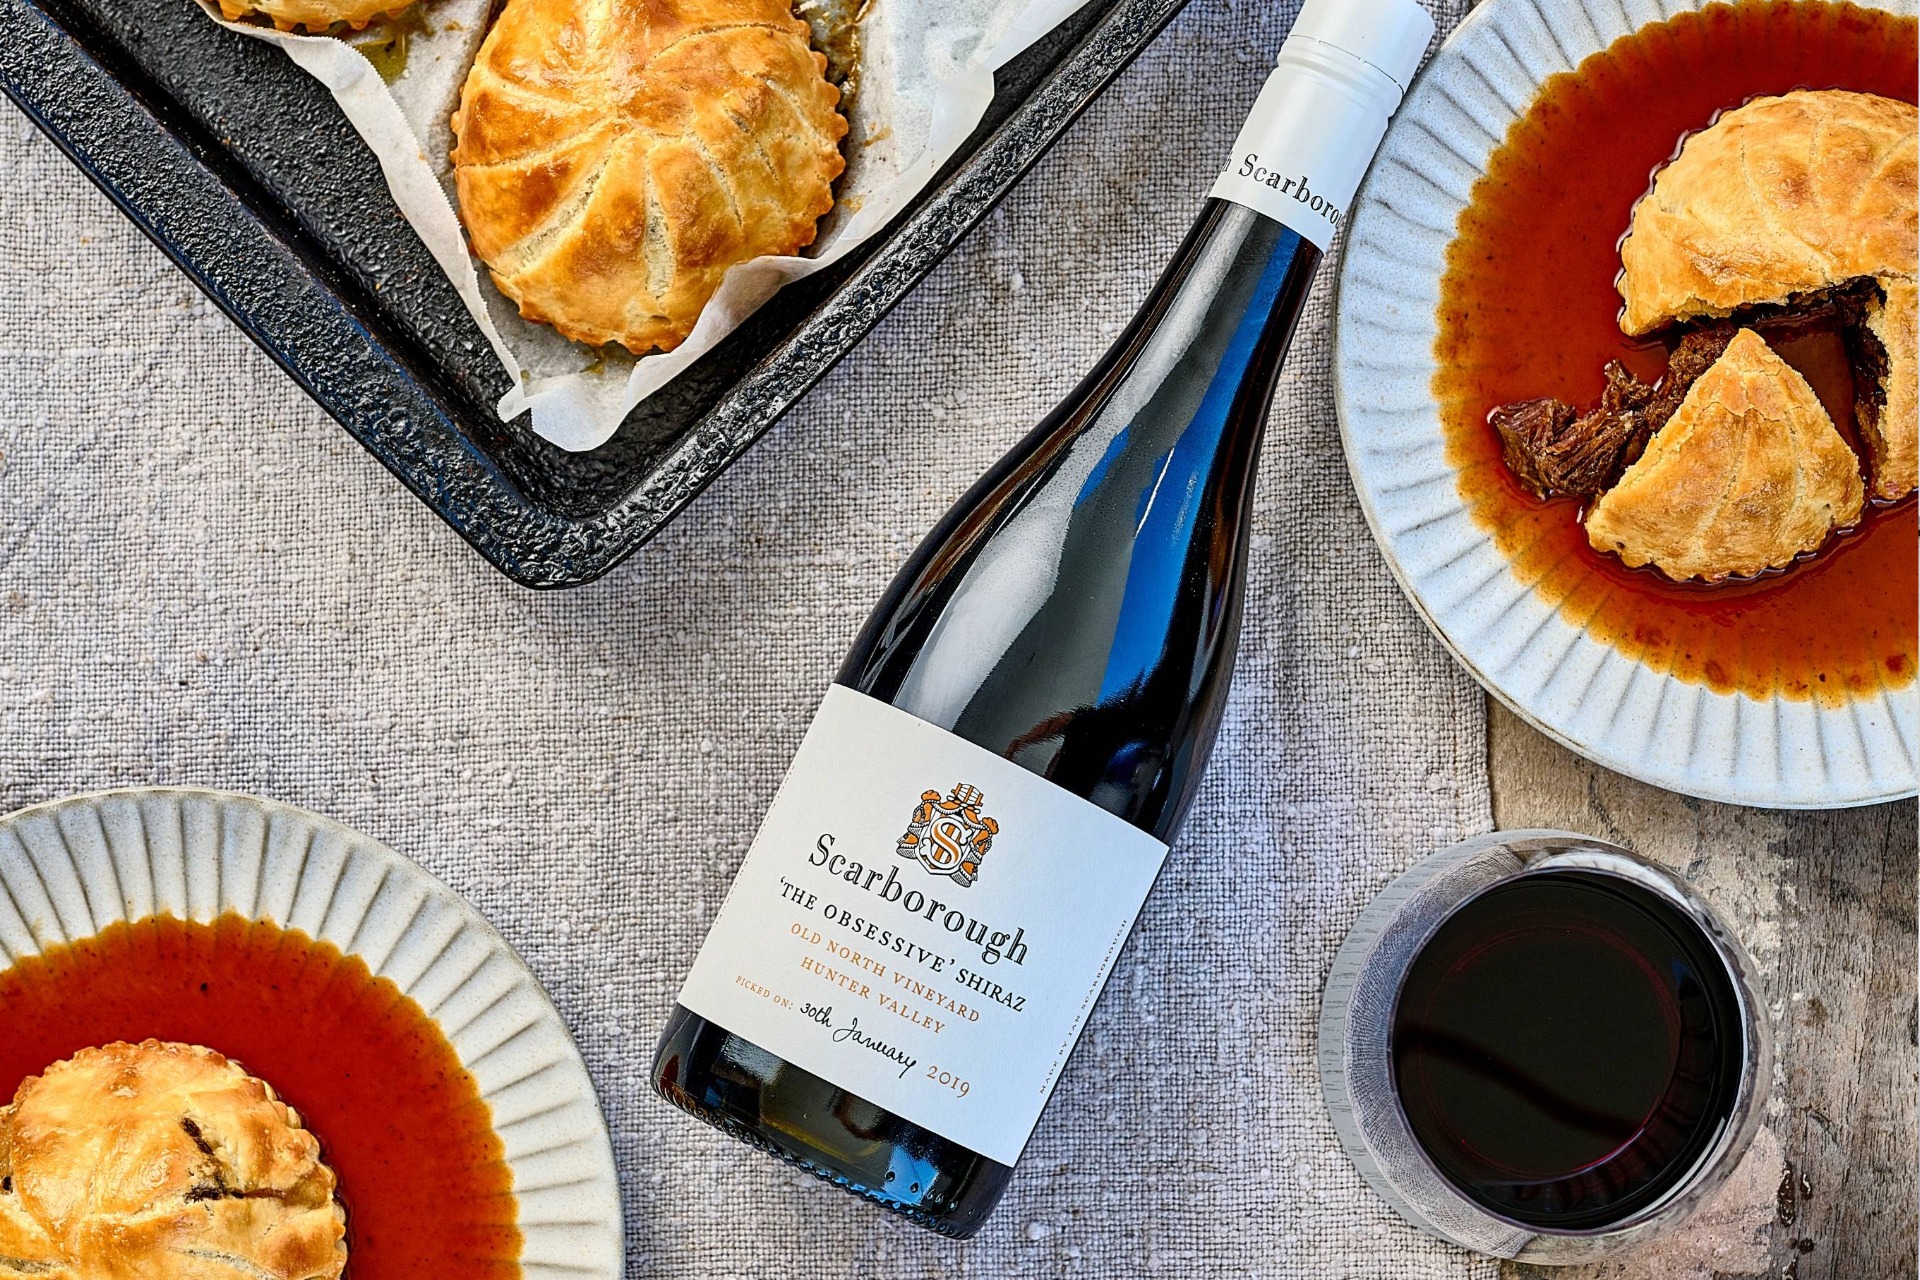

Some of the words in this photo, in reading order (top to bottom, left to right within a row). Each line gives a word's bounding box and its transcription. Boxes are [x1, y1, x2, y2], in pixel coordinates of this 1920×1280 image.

[808, 833, 1028, 966] Scarborough
[791, 923, 821, 945] OLD
[826, 940, 886, 977] NORTH
[893, 971, 980, 1022] VINEYARD
[800, 957, 871, 999] HUNTER
[879, 993, 946, 1034] VALLEY
[955, 968, 1027, 1012] SHIRAZ
[1039, 1061, 1058, 1094] MADE
[1058, 1041, 1067, 1056] BY
[1068, 1015, 1081, 1037] IAN
[1081, 919, 1128, 1011] SCARBOROUGH
[735, 975, 770, 998] PICKED
[773, 995, 794, 1010] ON:
[800, 1003, 832, 1028] 30th
[832, 1017, 917, 1079] January
[926, 1065, 970, 1099] 2019
